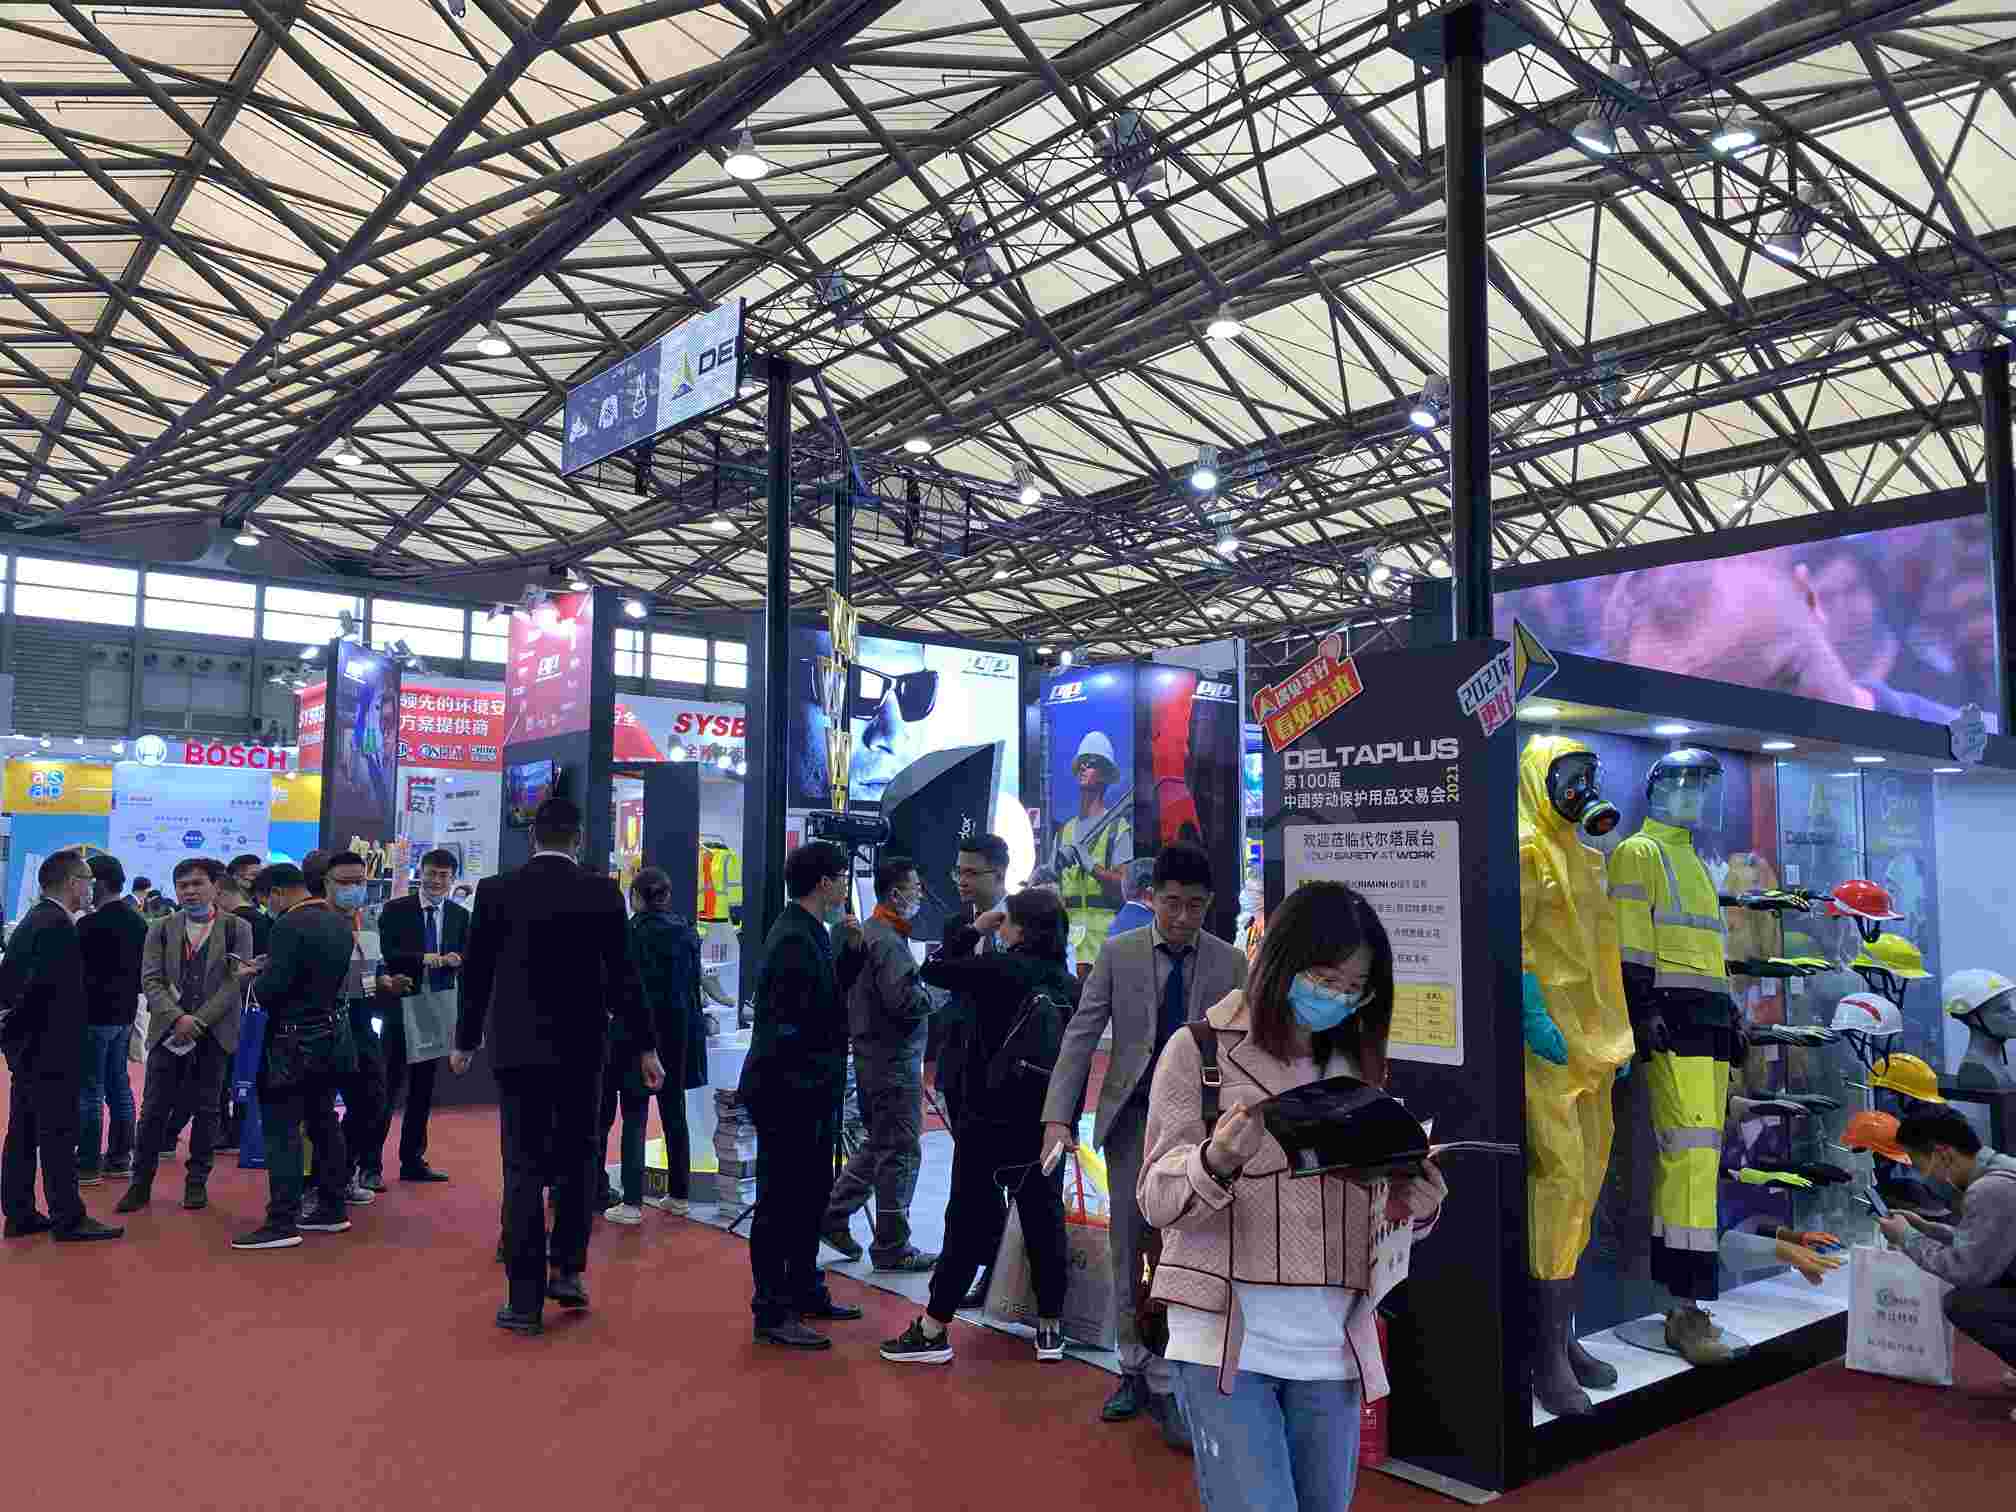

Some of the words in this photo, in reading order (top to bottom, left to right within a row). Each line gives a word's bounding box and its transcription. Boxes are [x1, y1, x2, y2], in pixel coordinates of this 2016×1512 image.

[400, 715, 489, 736] 方案提供商
[184, 740, 287, 769] BOSCH
[1284, 737, 1459, 770] DELTAPLUS
[1284, 772, 1341, 790] 第100届
[1446, 764, 1459, 802] 2021
[1284, 786, 1446, 809] 中国劳动保护用品交易会
[1304, 829, 1434, 849] 欢迎莅临代尔塔展台
[1334, 851, 1378, 860] SAFETY
[1397, 850, 1435, 860] WORK
